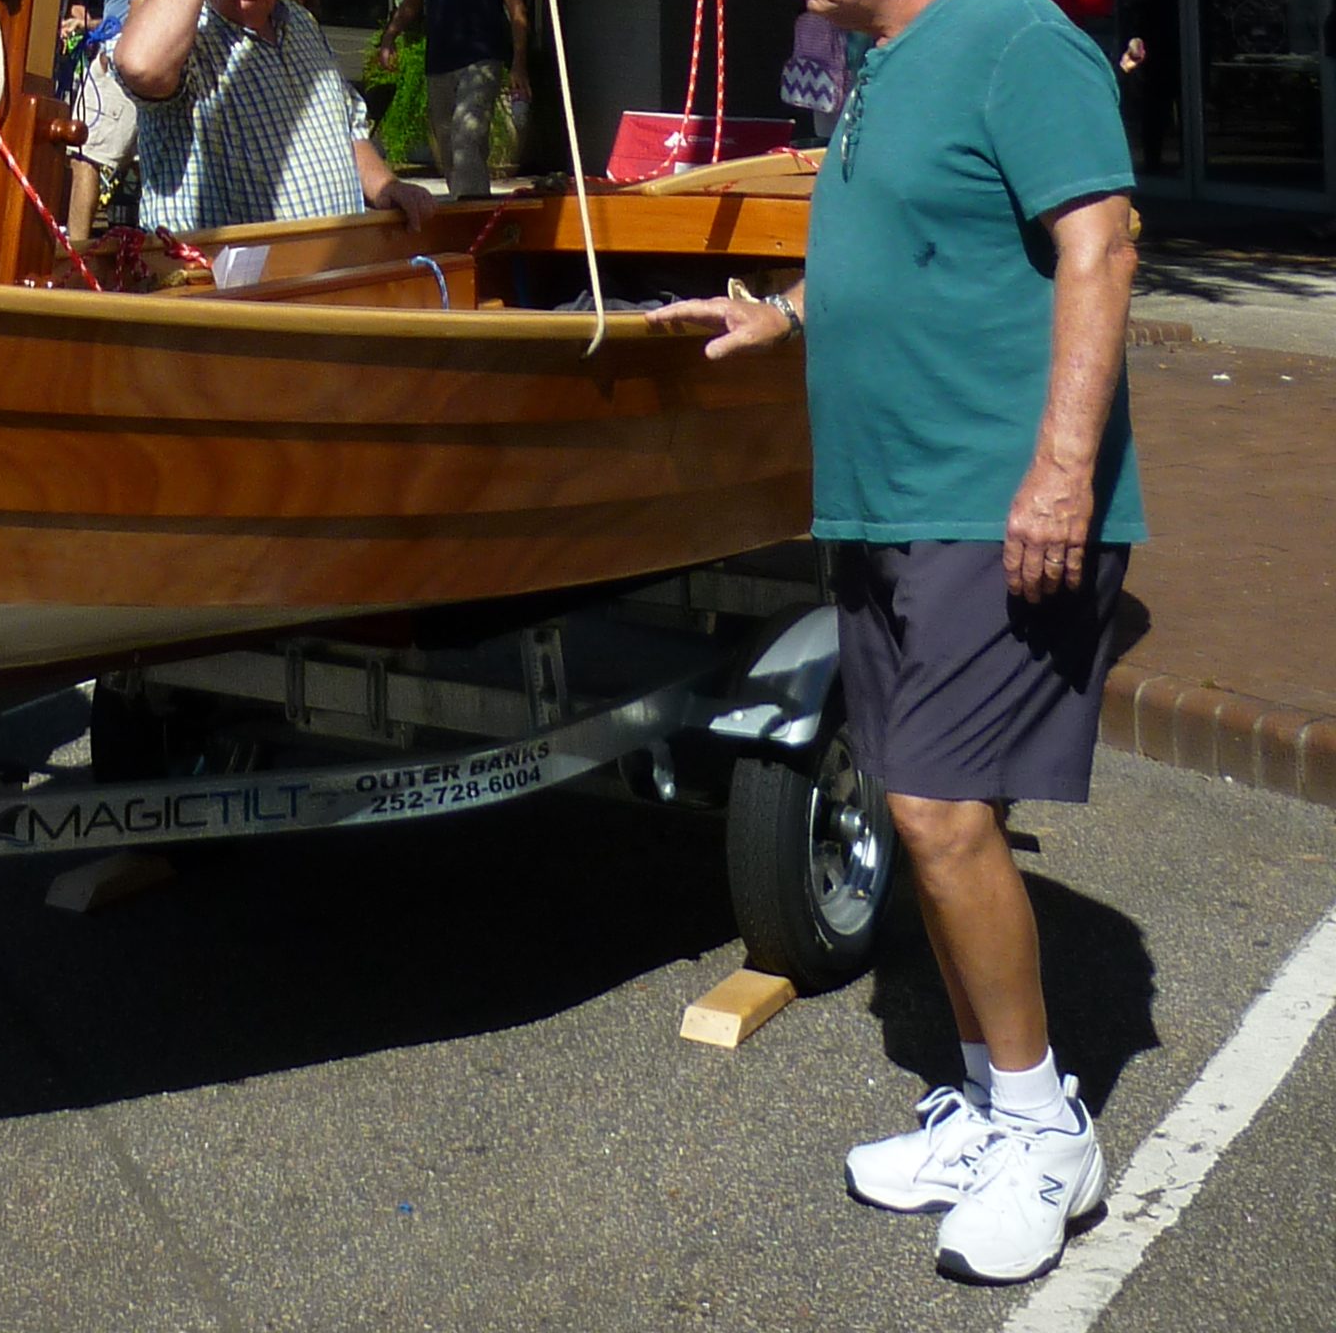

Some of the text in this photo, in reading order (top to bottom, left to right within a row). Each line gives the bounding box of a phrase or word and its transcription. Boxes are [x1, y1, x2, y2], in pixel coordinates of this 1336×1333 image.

[355, 740, 550, 793] OUTER BANKS
[370, 764, 542, 815] 252-728-6004
[26, 783, 311, 843] MAGICTILT
